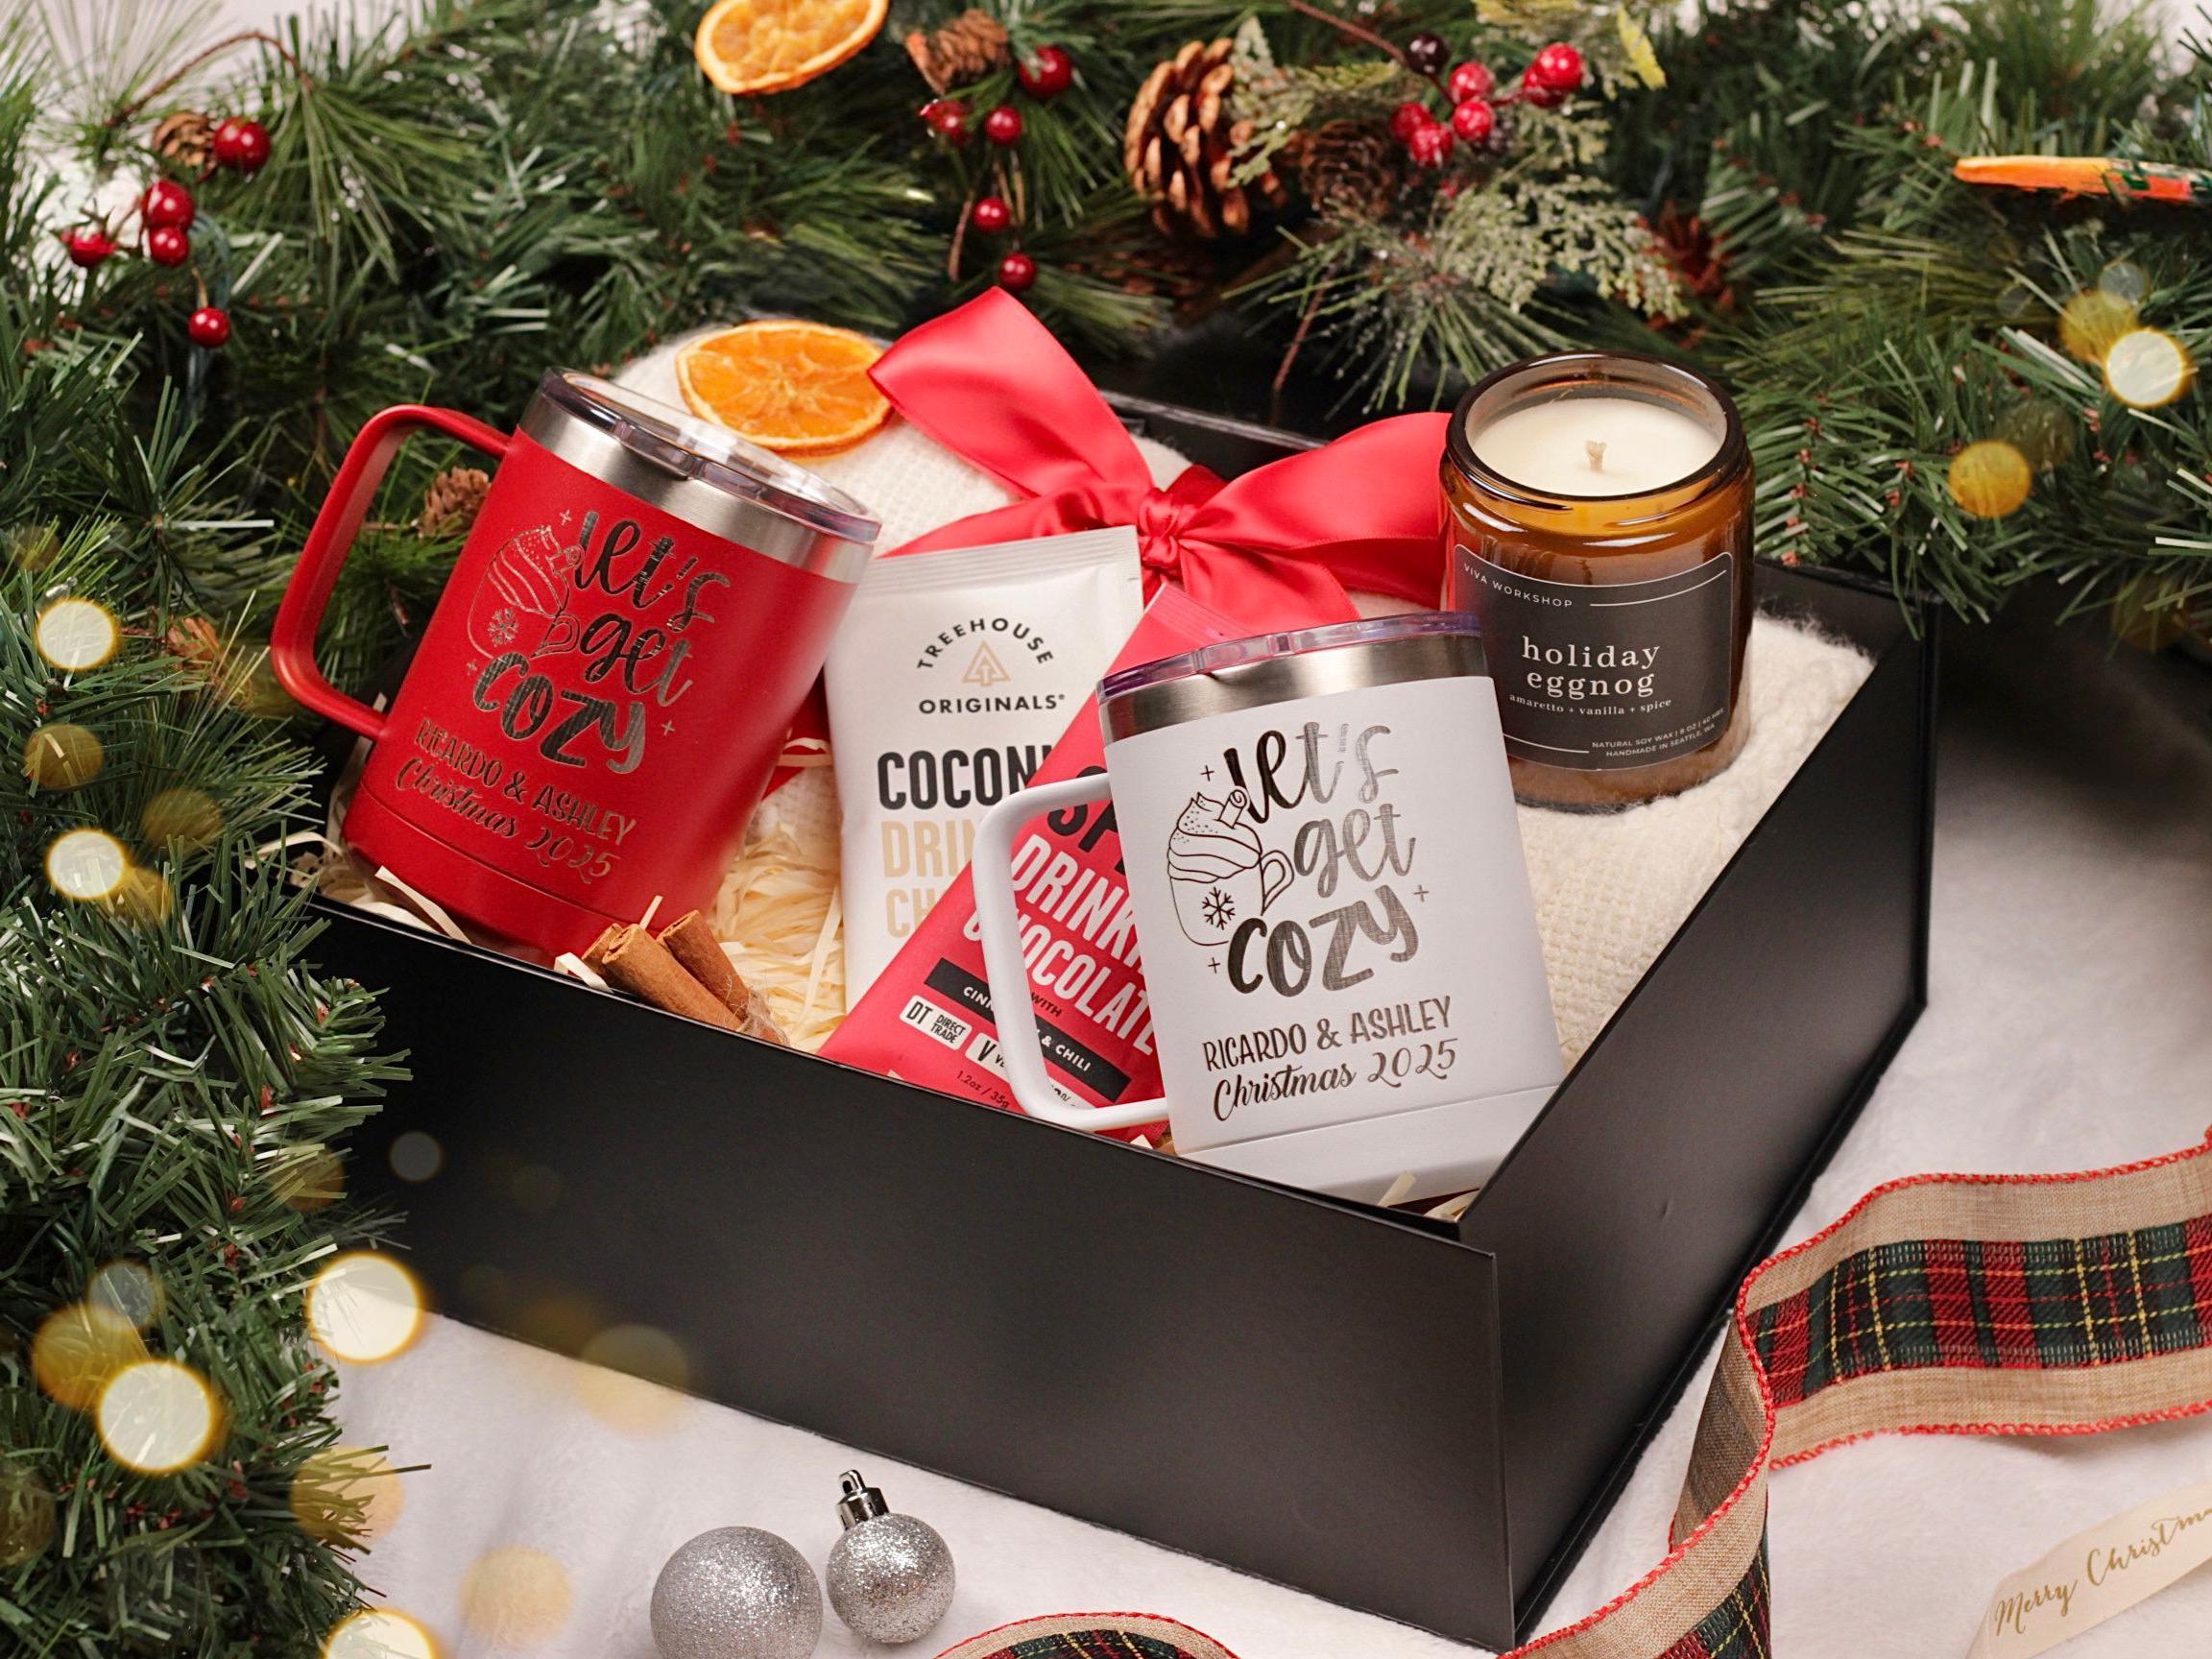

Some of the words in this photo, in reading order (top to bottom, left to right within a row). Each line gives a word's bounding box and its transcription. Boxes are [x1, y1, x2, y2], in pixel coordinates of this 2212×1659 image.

[1463, 563, 1488, 585] VIVA
[1493, 581, 1574, 608] WORKSHOP
[579, 613, 692, 708] get
[917, 617, 1054, 669] TREEHOUSE
[1522, 635, 1660, 669] holiday
[1509, 693, 1565, 713] amaretto
[1579, 706, 1625, 715] vanilla
[1640, 699, 1672, 712] spice
[1527, 671, 1655, 700] eggnog
[1592, 740, 1633, 749] NATURAL
[1635, 736, 1653, 745] SOY
[1654, 732, 1673, 742] WAX
[1605, 746, 1657, 757] HANDMADE
[1670, 732, 1703, 747] SEATTLE,
[413, 719, 503, 787] RICARDO
[503, 770, 528, 803] &
[532, 785, 637, 846] ASHLEY
[396, 757, 520, 838] Christmas
[523, 827, 620, 885] 2025
[1293, 803, 1416, 899] get
[906, 1000, 934, 1025] DT
[1031, 992, 1063, 1018] WITH
[929, 1022, 958, 1045] TRADE
[935, 1014, 967, 1037] DIRECT
[1203, 1025, 1309, 1071] RICARDO
[1316, 1018, 1342, 1050] &
[1350, 996, 1453, 1045] ASHLEY
[977, 1040, 998, 1062] V
[1041, 1035, 1052, 1047] &
[1055, 1044, 1092, 1072] CHILI
[956, 1070, 982, 1091] 1.2oz
[991, 1090, 1010, 1109] 35g
[1214, 1058, 1357, 1122] Christmas
[1367, 1038, 1458, 1089] 2025
[1994, 1579, 2079, 1637] Merry
